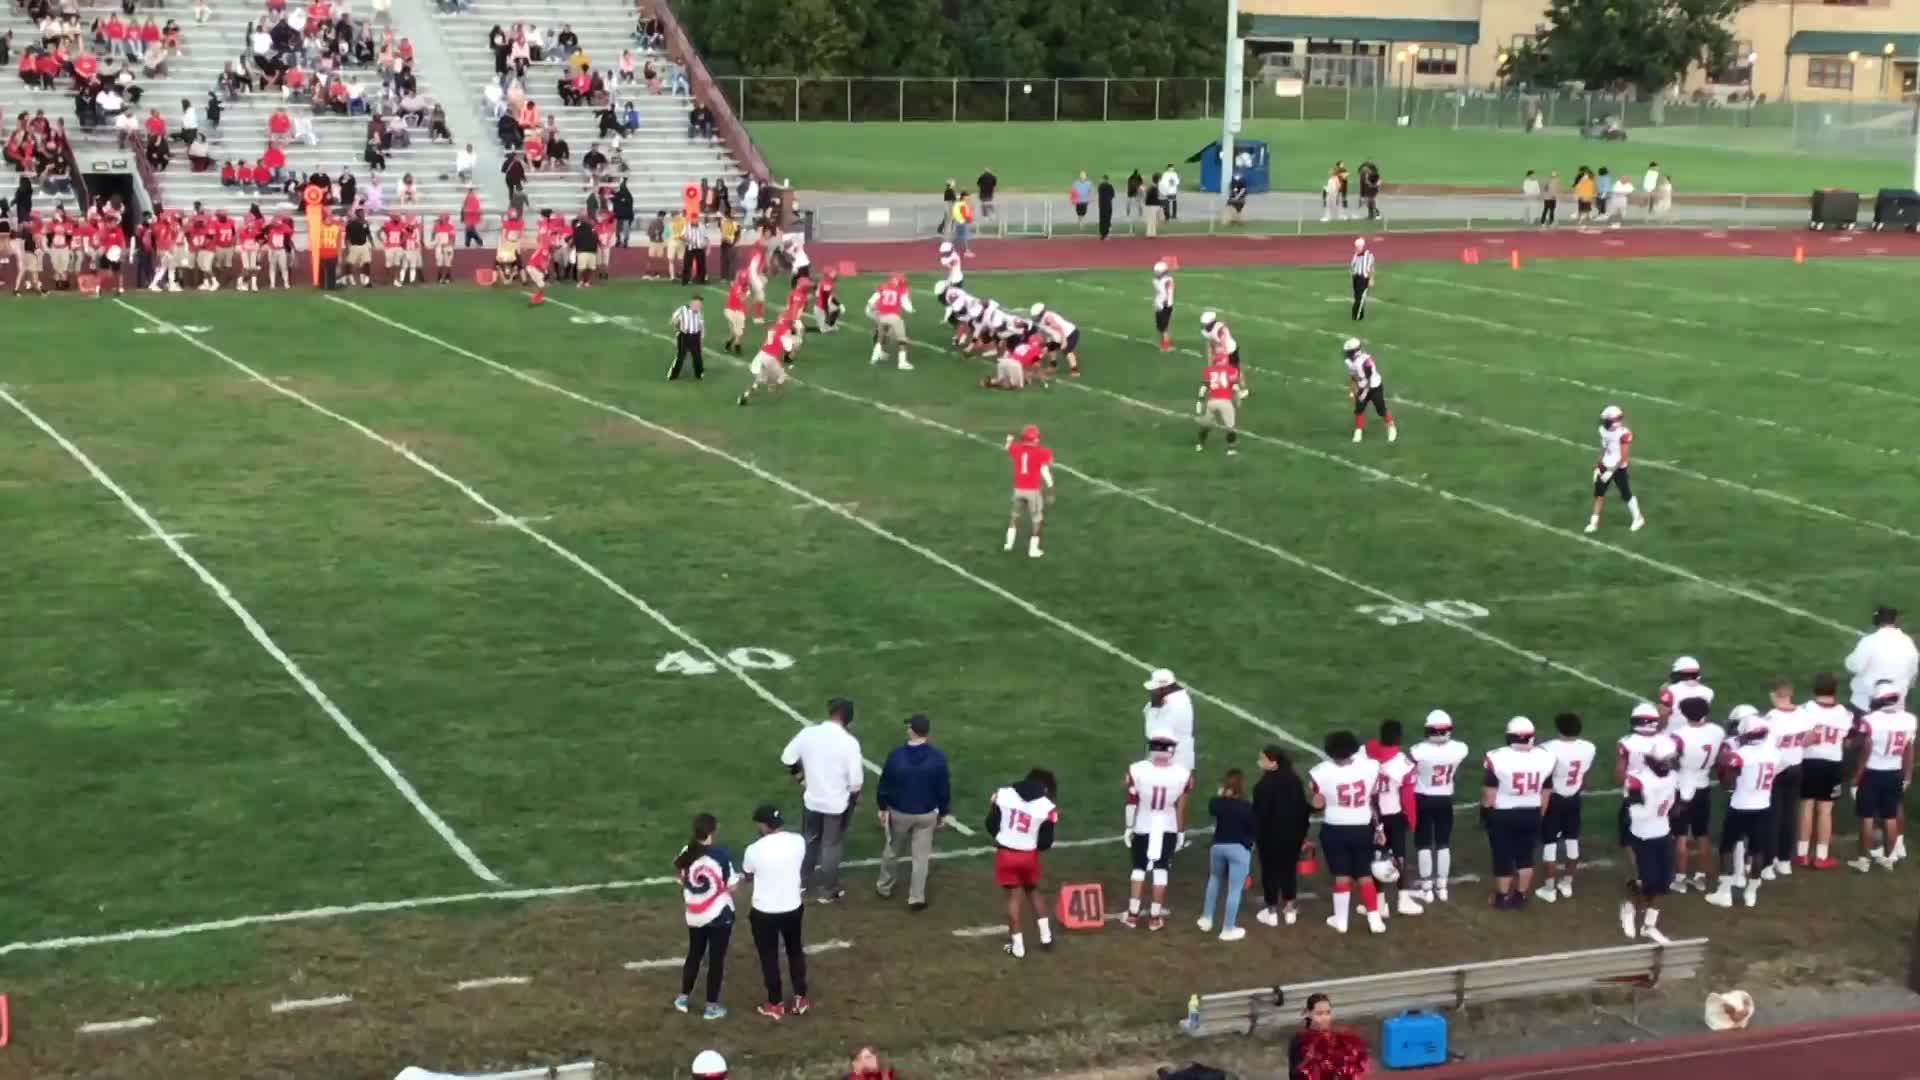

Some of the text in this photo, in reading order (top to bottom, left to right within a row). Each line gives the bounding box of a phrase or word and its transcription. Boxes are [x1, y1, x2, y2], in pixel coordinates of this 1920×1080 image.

[1210, 371, 1228, 389] 24
[1021, 453, 1028, 474] 1
[656, 646, 796, 675] 40
[1700, 744, 1712, 769] 7
[1431, 764, 1453, 787] 21
[1512, 772, 1540, 795] 54
[1566, 760, 1582, 787] 3
[1756, 762, 1774, 790] 12
[1151, 786, 1167, 810] 11
[1336, 780, 1366, 807] 52
[1068, 890, 1100, 922] 40
